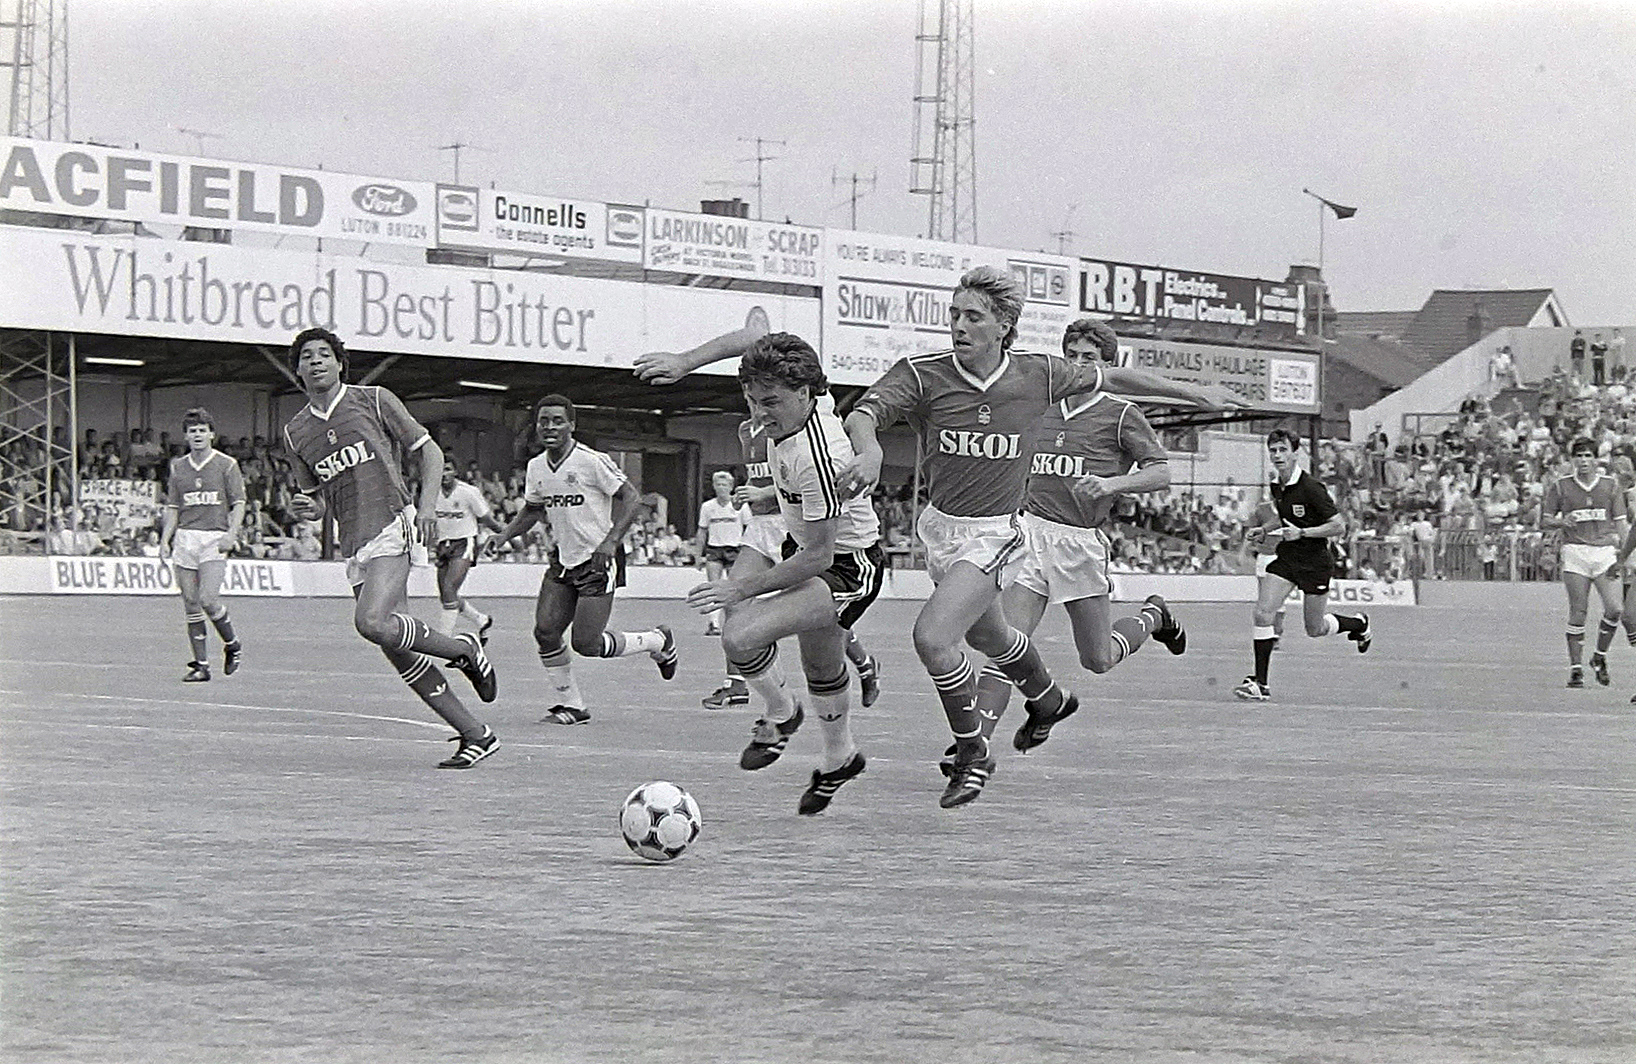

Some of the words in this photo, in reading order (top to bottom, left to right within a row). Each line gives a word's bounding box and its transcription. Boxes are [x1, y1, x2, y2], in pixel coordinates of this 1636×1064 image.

[0, 145, 325, 228] ACFIELD
[361, 186, 404, 213] Ford
[341, 217, 380, 234] LUTON
[495, 196, 587, 229] Connells
[553, 234, 594, 252] agents
[652, 215, 749, 249] LARKINSON
[768, 229, 819, 257] SCRAP
[61, 243, 340, 331] Whitbread
[355, 269, 455, 343] Best
[469, 279, 596, 352] Bitter
[905, 290, 953, 327] Kilbu
[1138, 348, 1202, 371] REMOVALS
[939, 429, 1023, 459] SKOL
[315, 440, 376, 482] SKOL
[1031, 453, 1090, 478] SKOL
[183, 491, 222, 506] SKOL
[56, 561, 106, 589] BLUE
[113, 562, 173, 590] ARRO
[223, 564, 282, 592] AVEL
